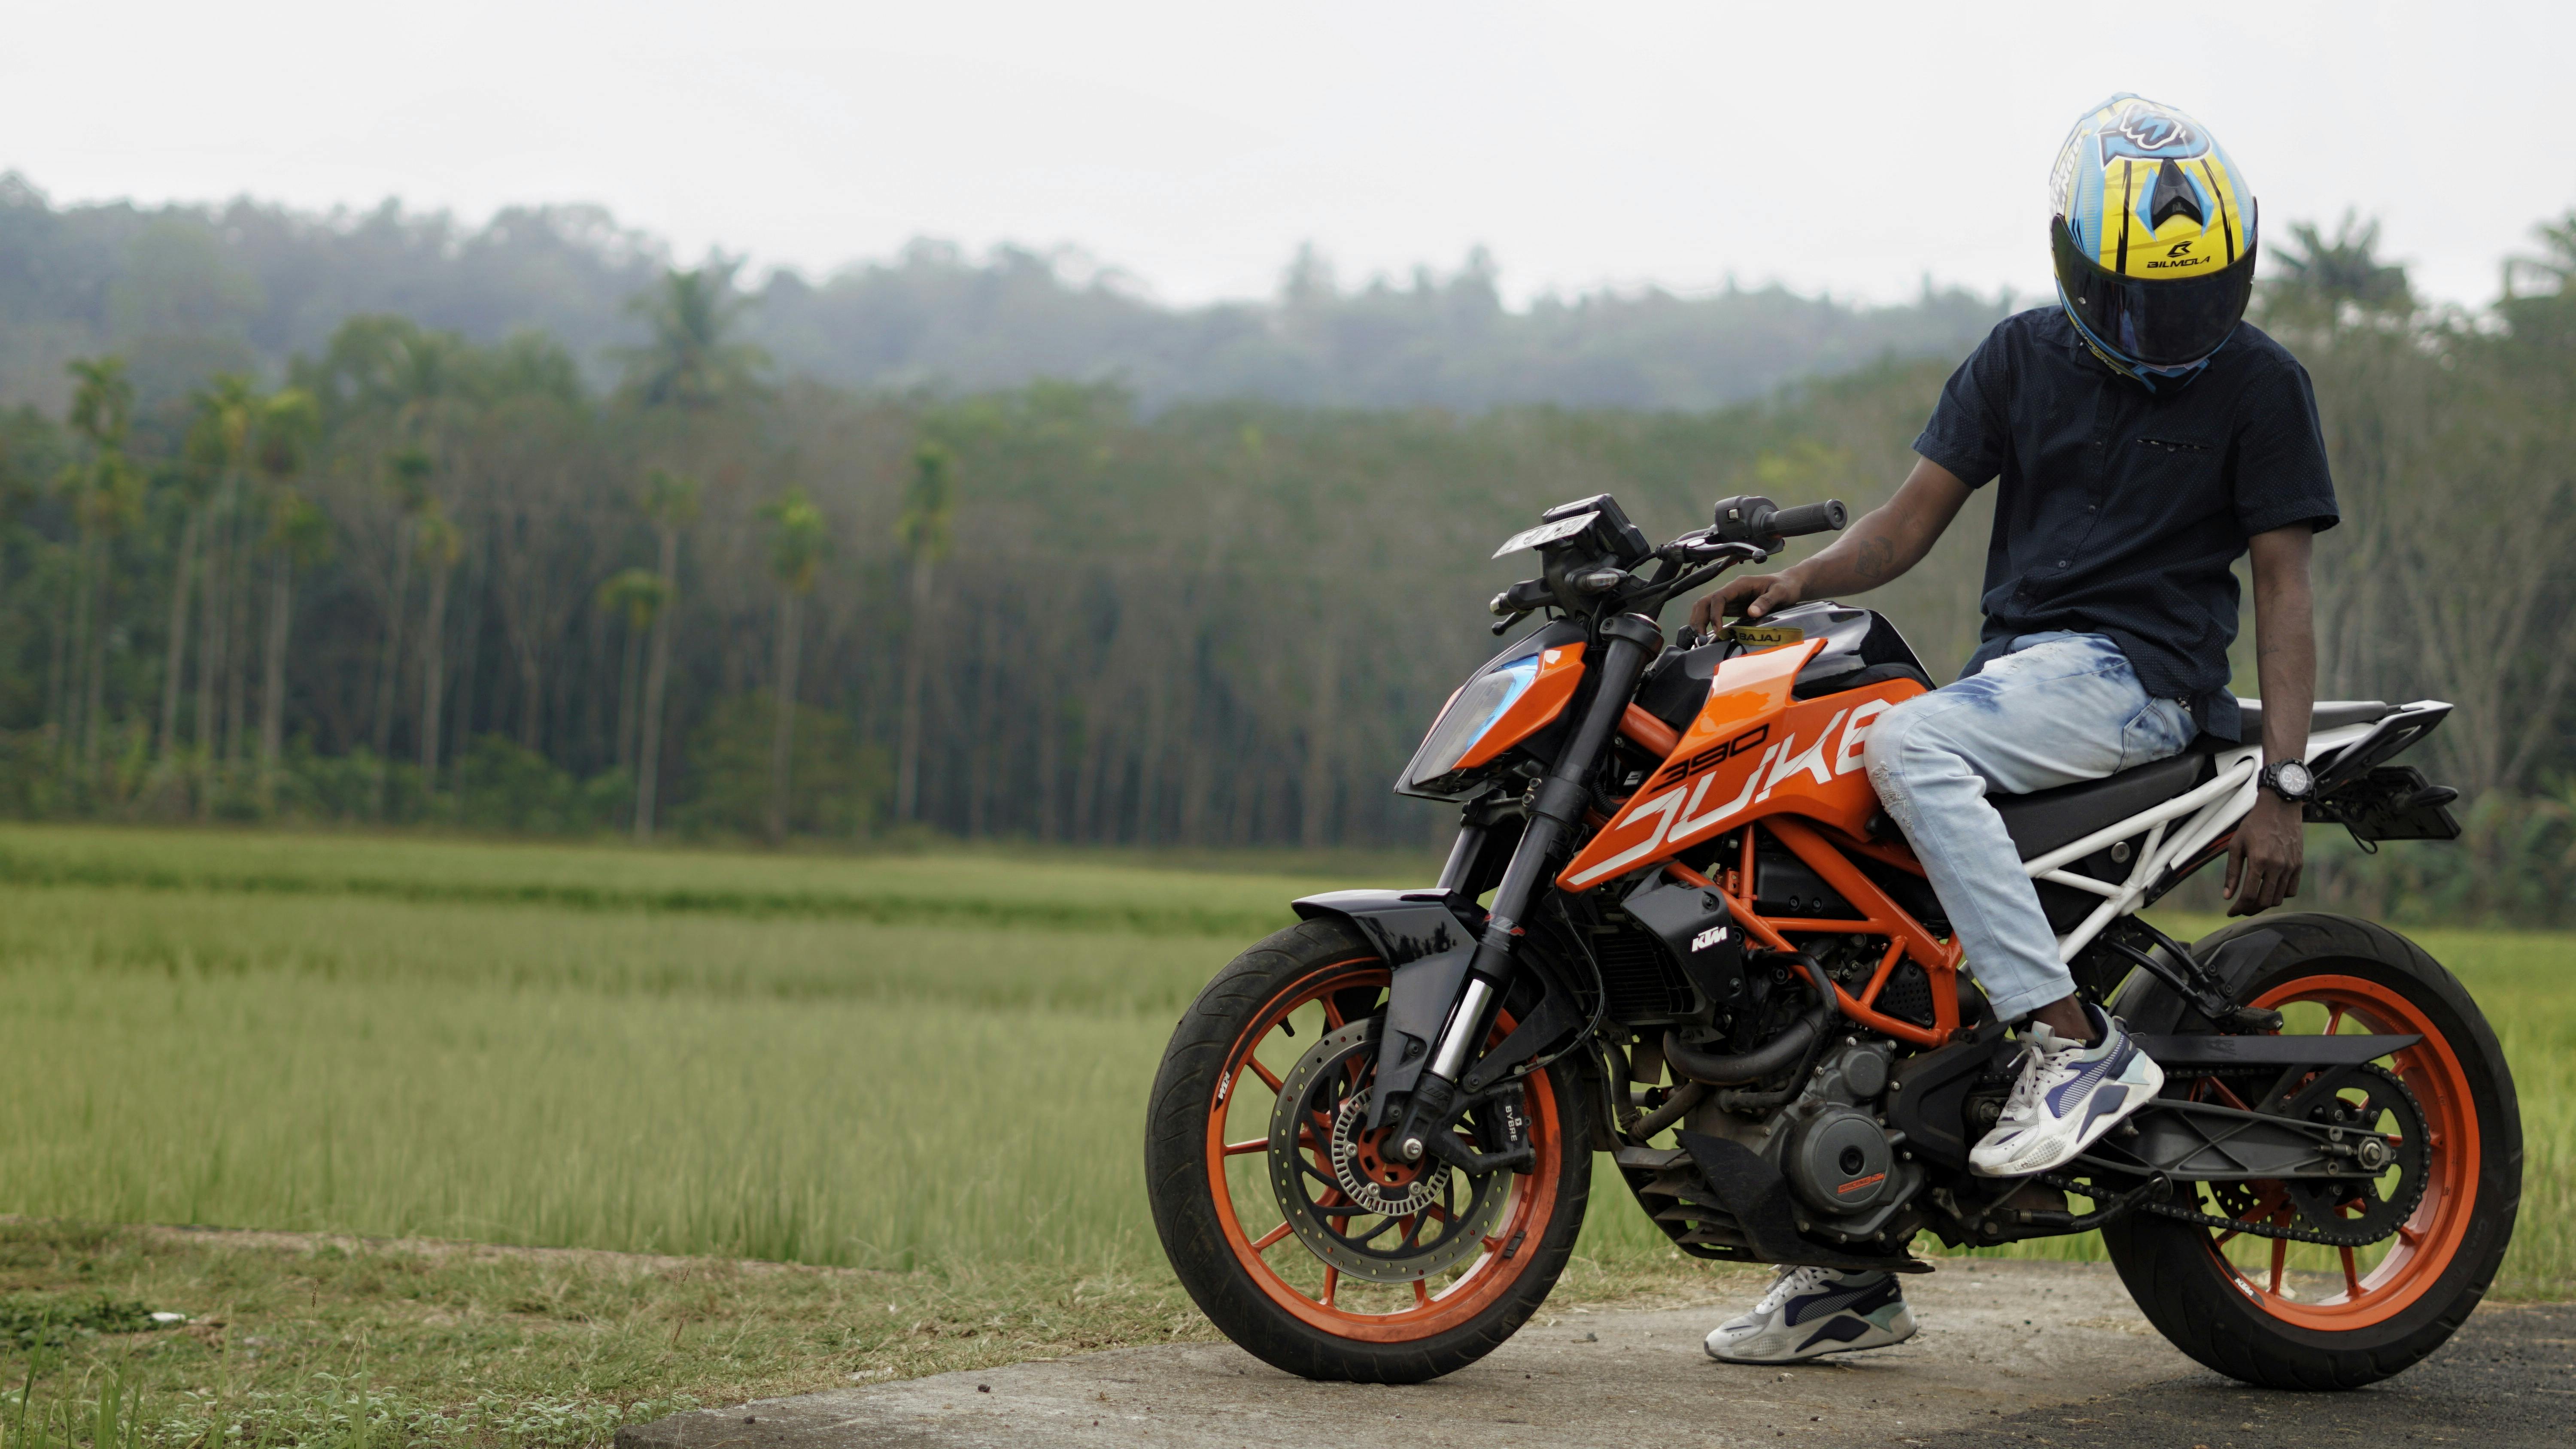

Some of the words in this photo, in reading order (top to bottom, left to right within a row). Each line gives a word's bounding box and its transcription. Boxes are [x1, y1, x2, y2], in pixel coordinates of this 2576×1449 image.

[2147, 256, 2210, 268] BILMOLA
[1739, 633, 1781, 642] BAJAJ
[1647, 723, 1769, 794] 390
[1567, 698, 1893, 885] DUKE
[1692, 926, 1727, 952] KTM
[1218, 1071, 1230, 1100] KTM
[1505, 1105, 1518, 1142] BYBRE
[2234, 1278, 2254, 1296] KTM
